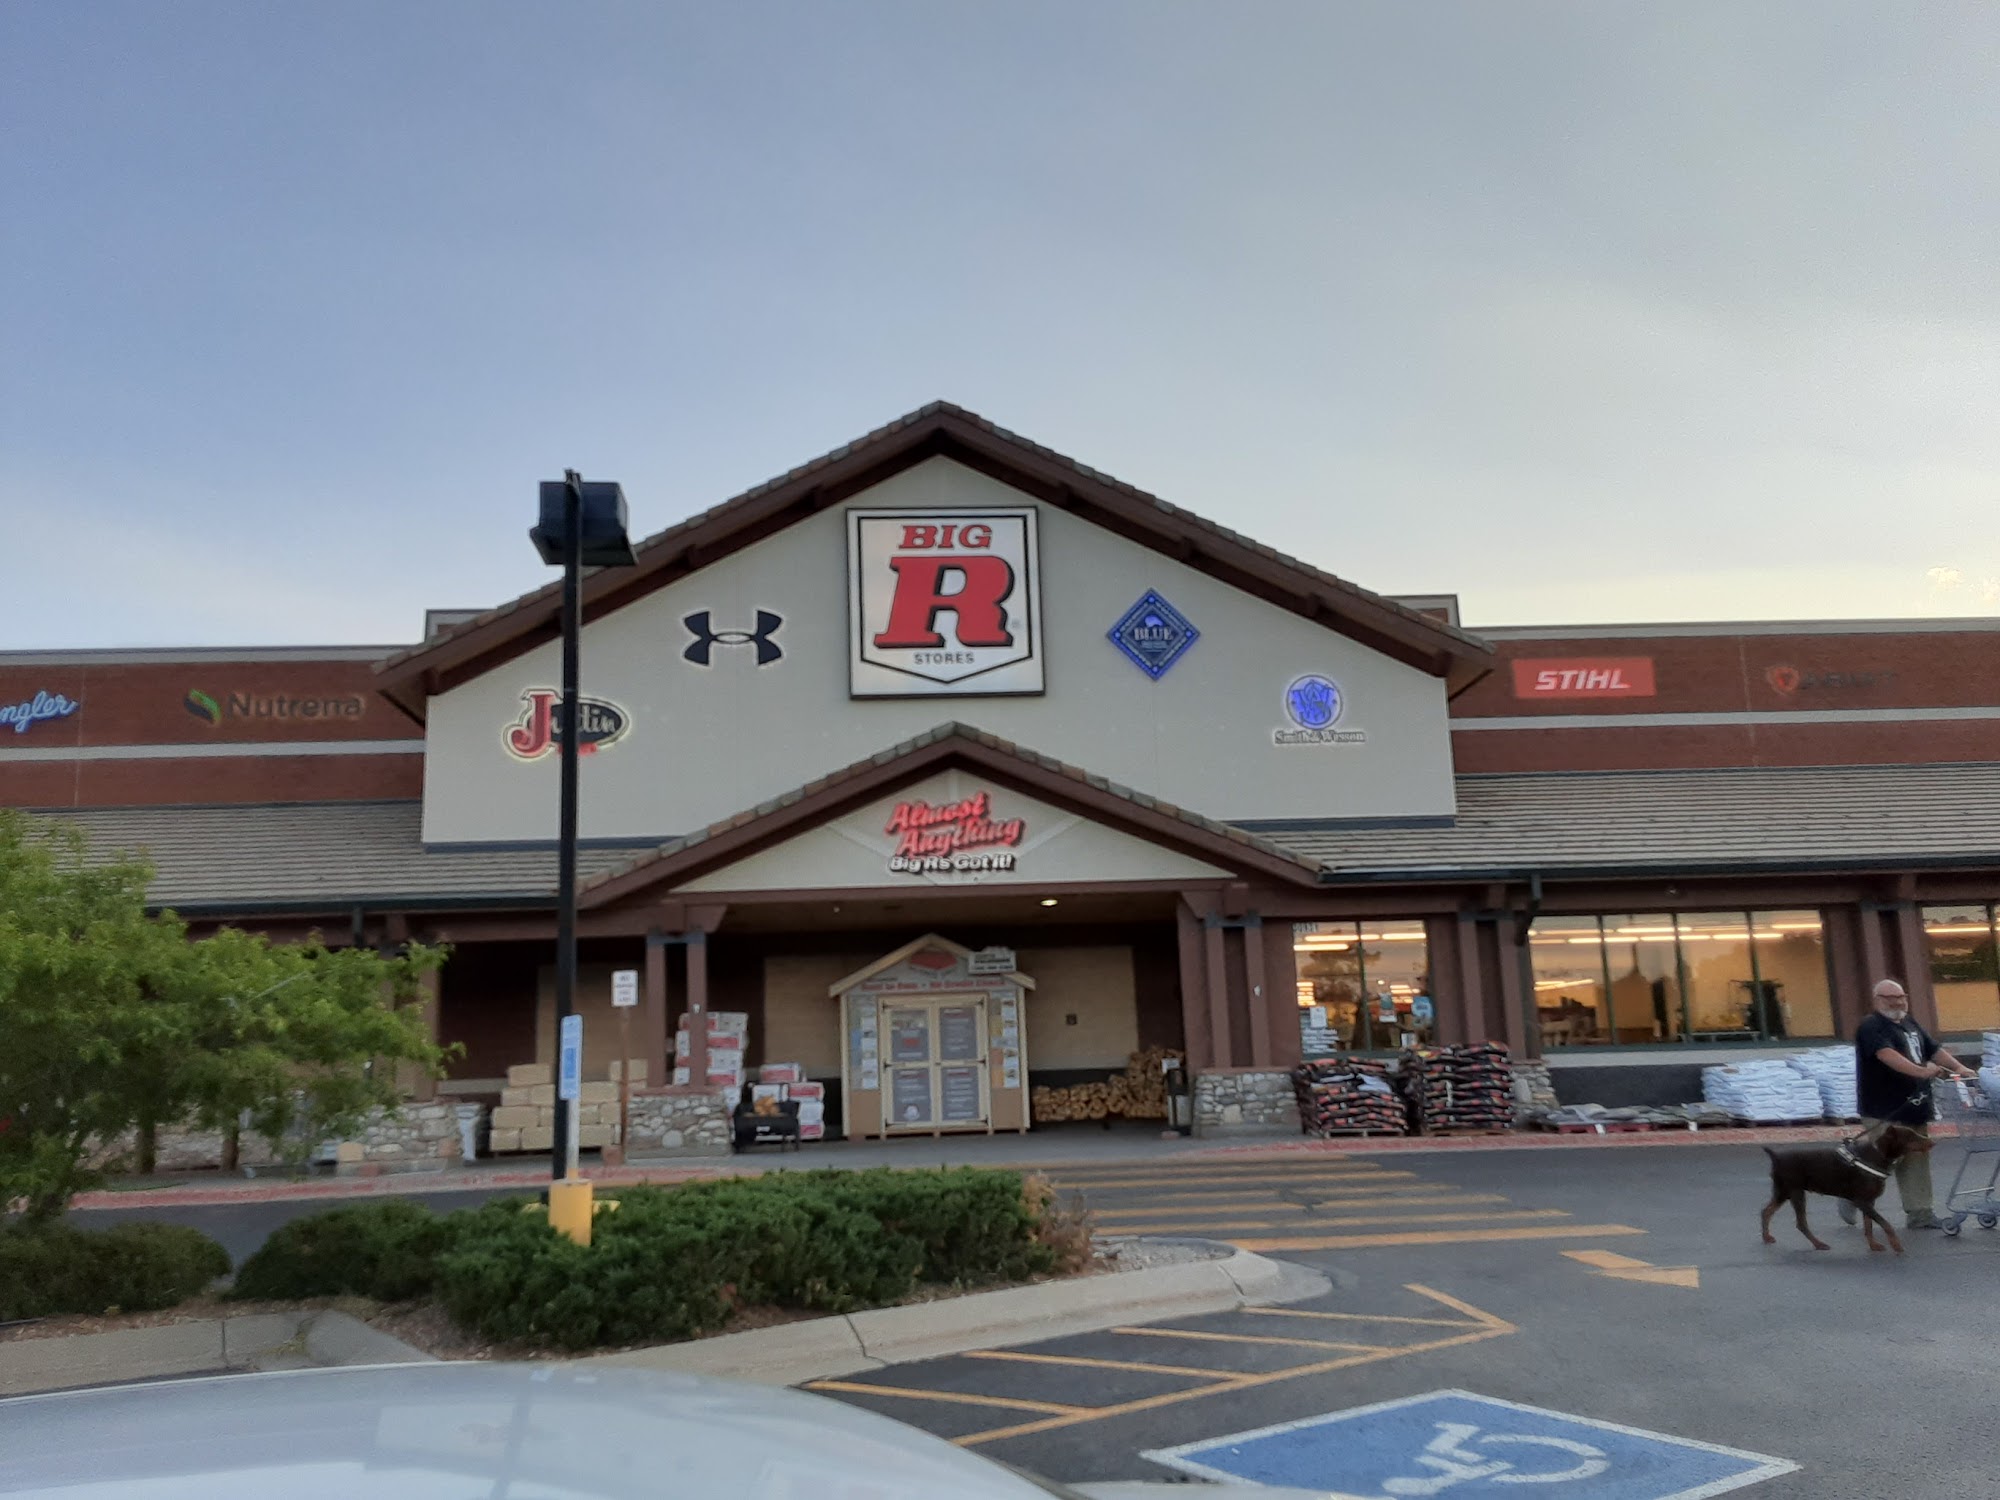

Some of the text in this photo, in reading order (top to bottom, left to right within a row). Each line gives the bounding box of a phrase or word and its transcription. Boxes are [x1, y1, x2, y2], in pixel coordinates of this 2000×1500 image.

[899, 525, 993, 549] BIG
[874, 556, 1015, 649] R
[914, 652, 975, 665] STORES
[1534, 669, 1632, 691] STIHL
[226, 692, 362, 718] Nutrena
[885, 793, 987, 833] Almost
[896, 817, 1023, 858] Anything
[890, 856, 921, 873] Big
[954, 854, 989, 870] Got
